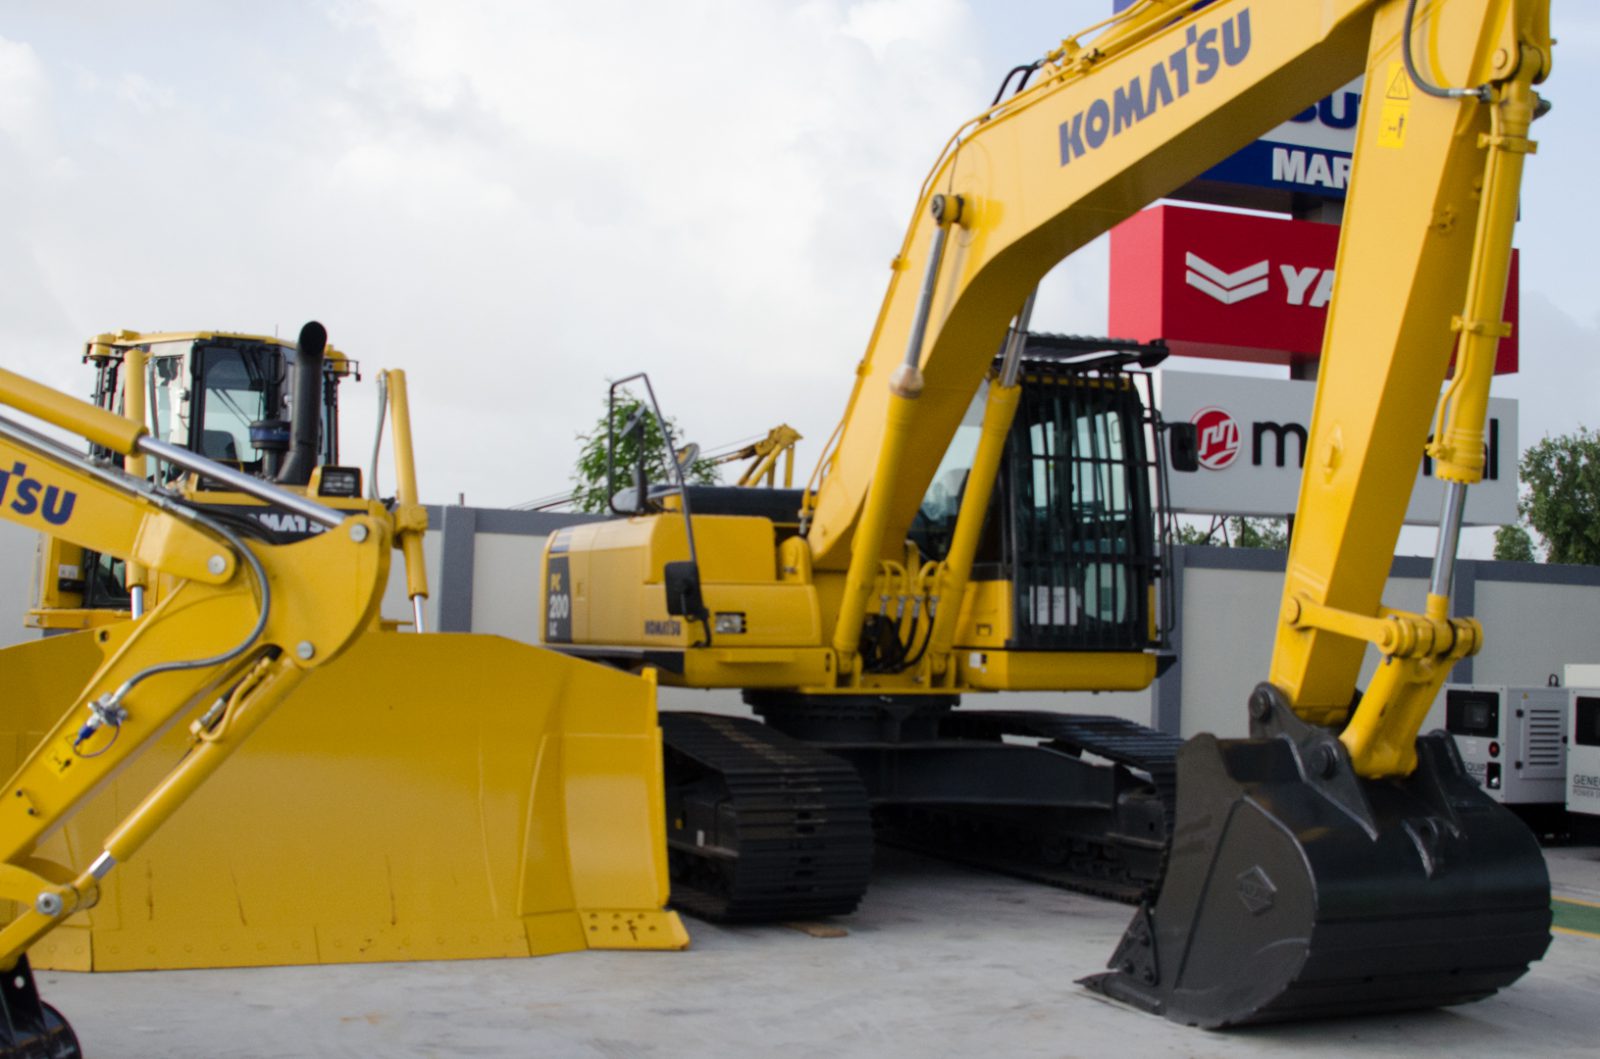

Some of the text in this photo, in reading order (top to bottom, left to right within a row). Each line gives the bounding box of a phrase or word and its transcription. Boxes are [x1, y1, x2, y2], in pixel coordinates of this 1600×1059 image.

[1059, 8, 1251, 167] KOMATSU
[549, 594, 569, 618] 200
[644, 620, 681, 636] KOMATSU
